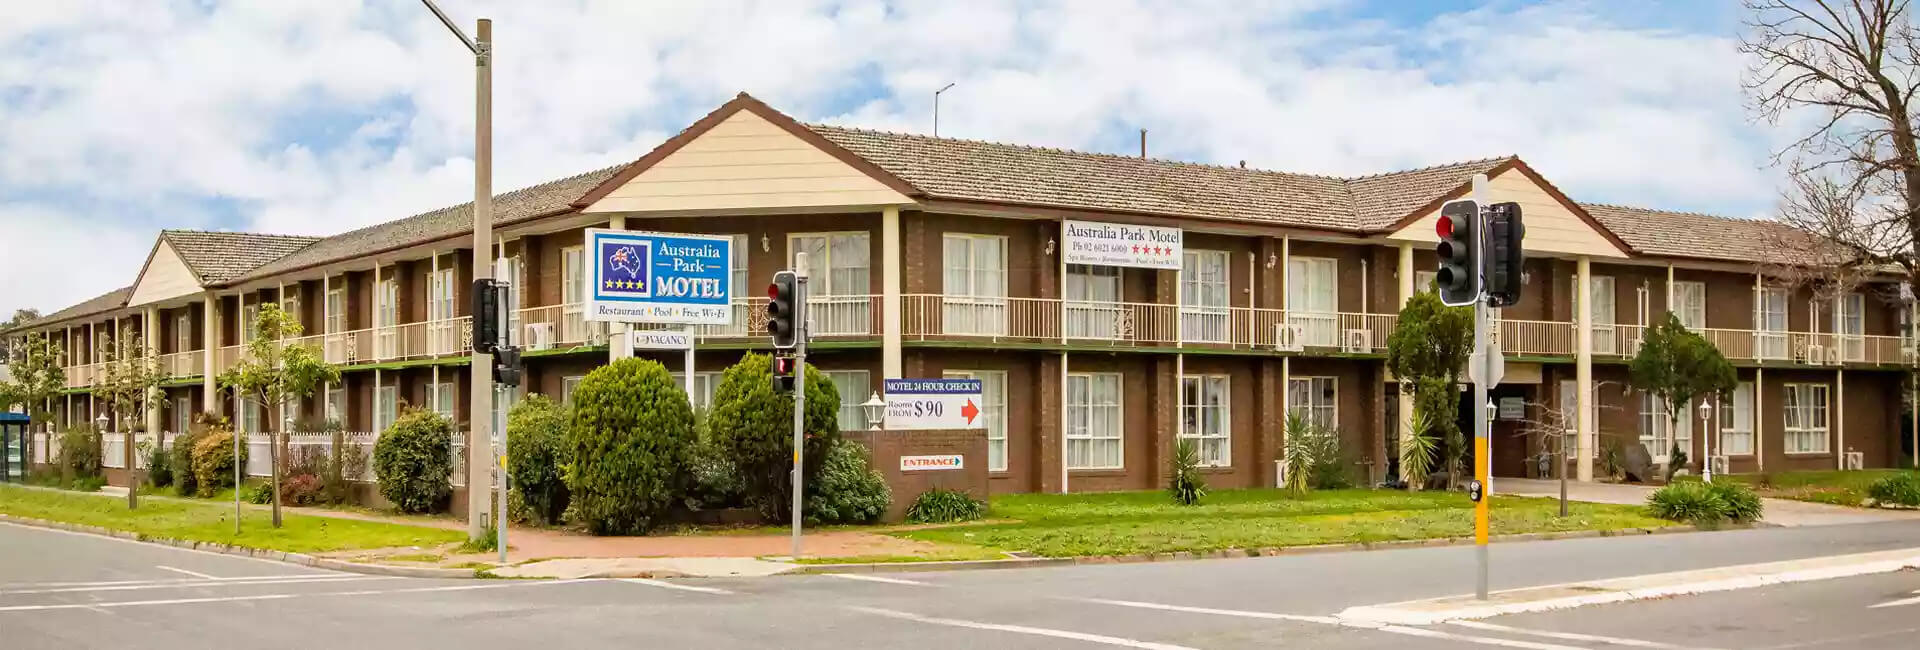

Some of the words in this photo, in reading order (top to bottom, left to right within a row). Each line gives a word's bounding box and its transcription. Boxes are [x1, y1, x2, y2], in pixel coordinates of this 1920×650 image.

[1066, 223, 1117, 239] Australia
[1120, 227, 1145, 241] Park
[1149, 229, 1179, 243] Motel
[658, 241, 720, 258] Australia
[1073, 241, 1082, 250] Ph
[1084, 242, 1092, 251] 02
[673, 257, 705, 272] Park
[656, 276, 725, 299] MOTEL
[598, 304, 644, 316] Restaurant
[654, 306, 672, 317] Pool
[682, 308, 700, 318] Free
[702, 309, 725, 319] Wi-Fi
[650, 335, 688, 345] VACANCY
[887, 383, 913, 391] MOTEL
[914, 383, 921, 391] 24
[922, 383, 945, 391] HOUR
[945, 383, 971, 391] CHECK
[971, 382, 980, 391] IN
[888, 400, 913, 408] Rooms
[888, 409, 912, 417] FROM
[903, 458, 954, 467] ENTRANCE
